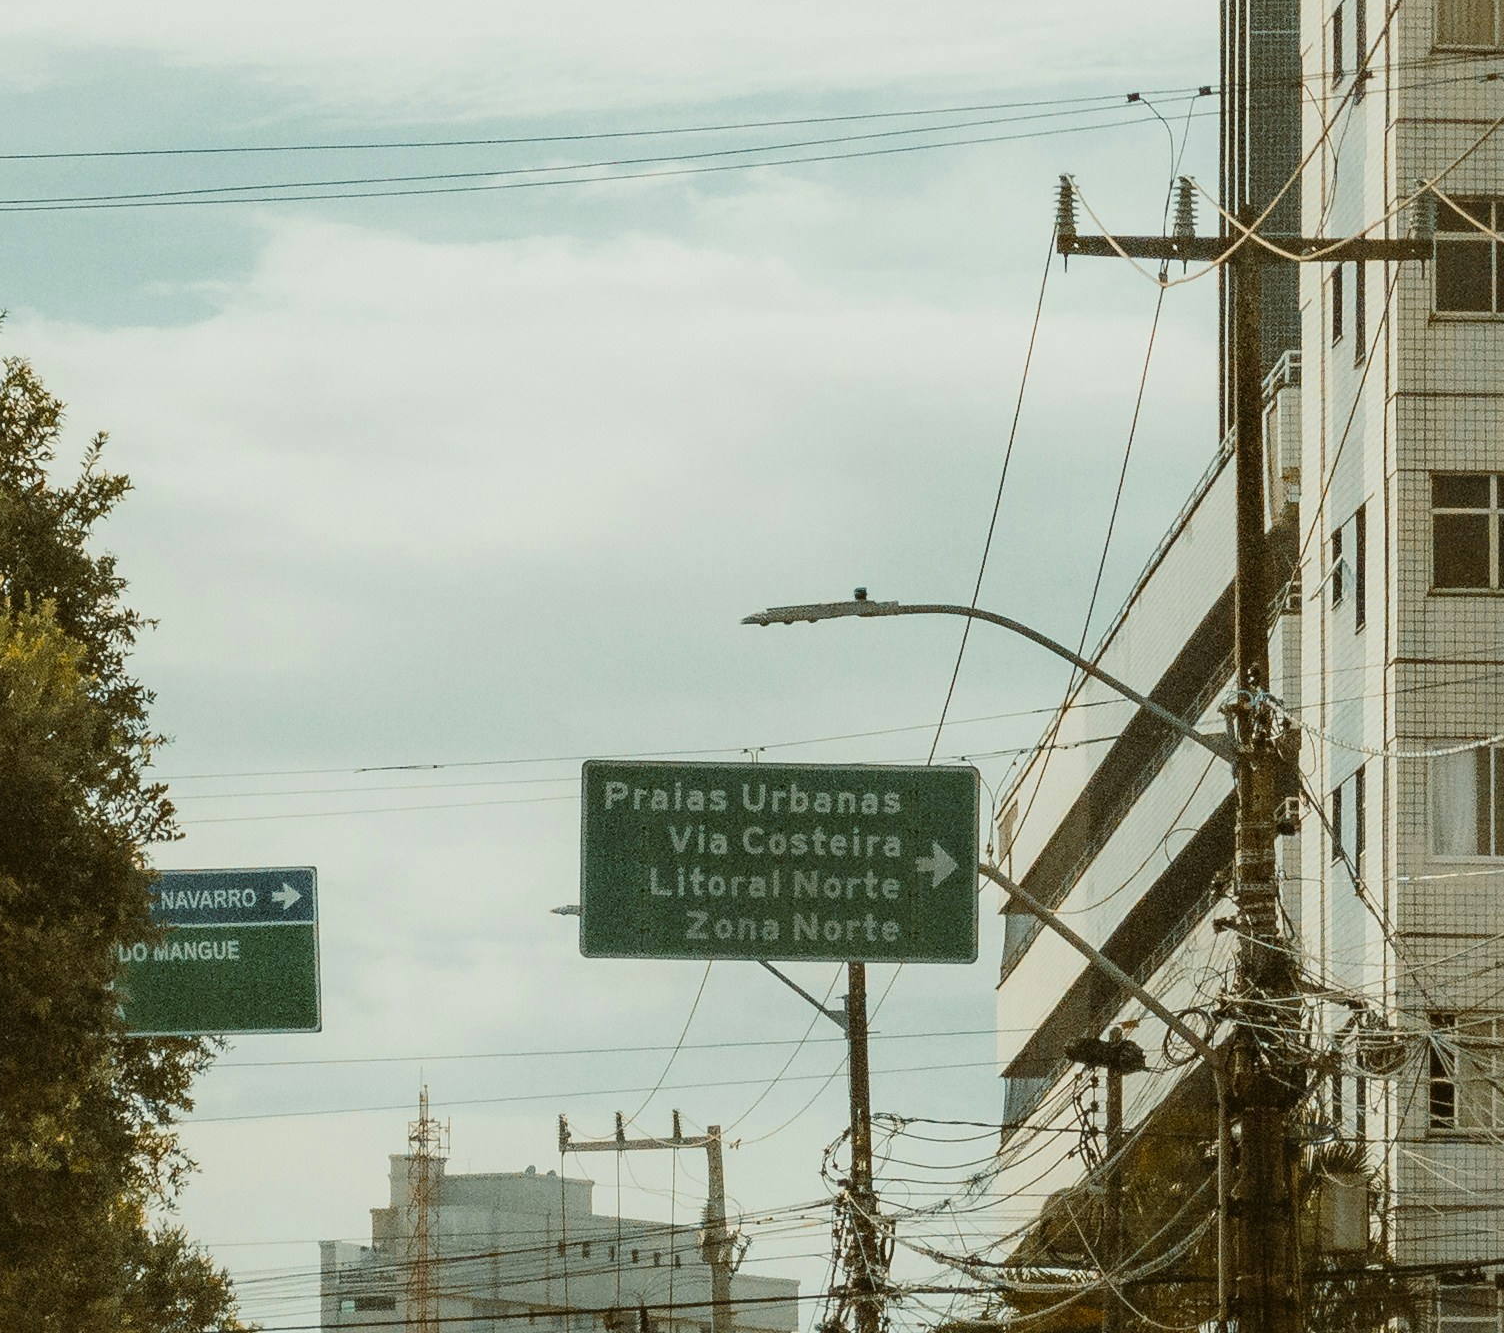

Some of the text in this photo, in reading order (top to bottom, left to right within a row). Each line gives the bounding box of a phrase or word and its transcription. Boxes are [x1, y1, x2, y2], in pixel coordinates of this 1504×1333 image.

[604, 781, 902, 815] Praias Urbanas
[669, 825, 902, 858] Via Costeira
[160, 888, 257, 910] NAVARRO
[649, 867, 901, 900] Litoral Norte
[684, 910, 900, 943] Zona Norte
[153, 939, 241, 961] MANGUE
